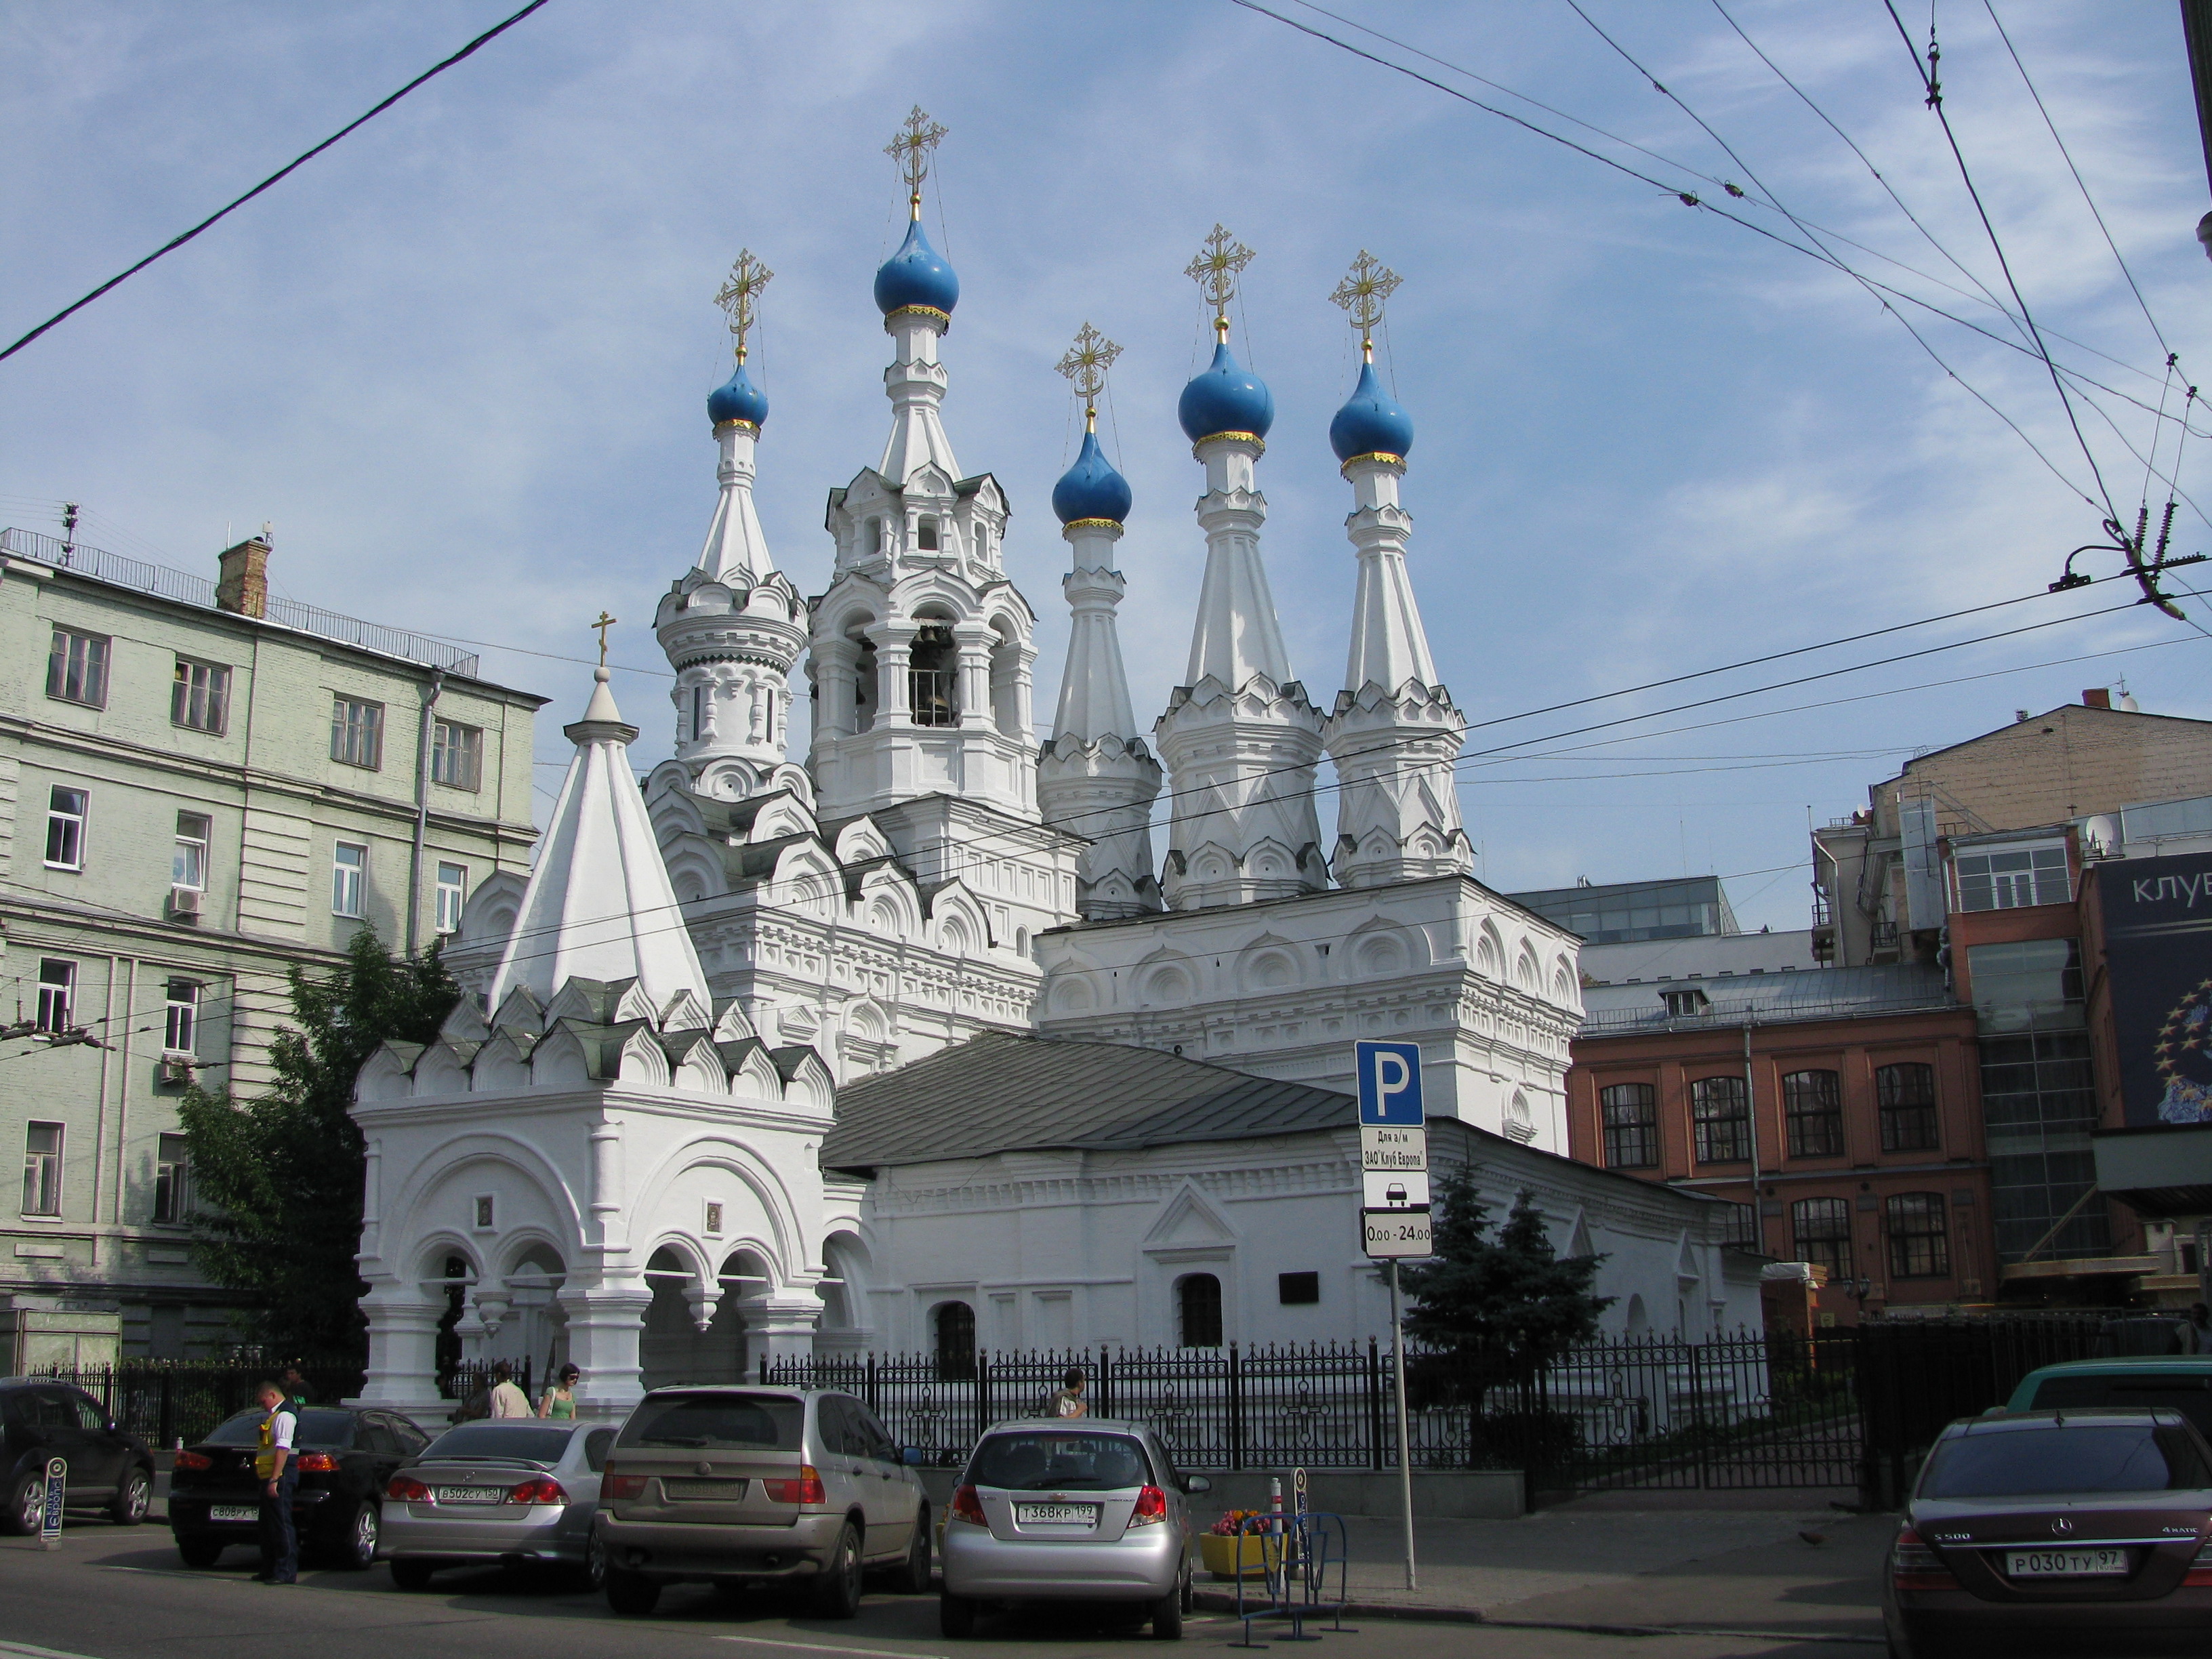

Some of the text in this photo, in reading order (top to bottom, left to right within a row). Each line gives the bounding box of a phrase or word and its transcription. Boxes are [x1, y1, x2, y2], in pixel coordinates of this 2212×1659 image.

[1374, 1051, 1410, 1116] P
[1378, 1129, 1408, 1144] Для а/м
[1367, 1226, 1390, 1241] 0.00
[1399, 1225, 1430, 1241] 24.00
[485, 1488, 498, 1496] 150
[1075, 1506, 1092, 1515] 199
[2098, 1551, 2117, 1565] 97
